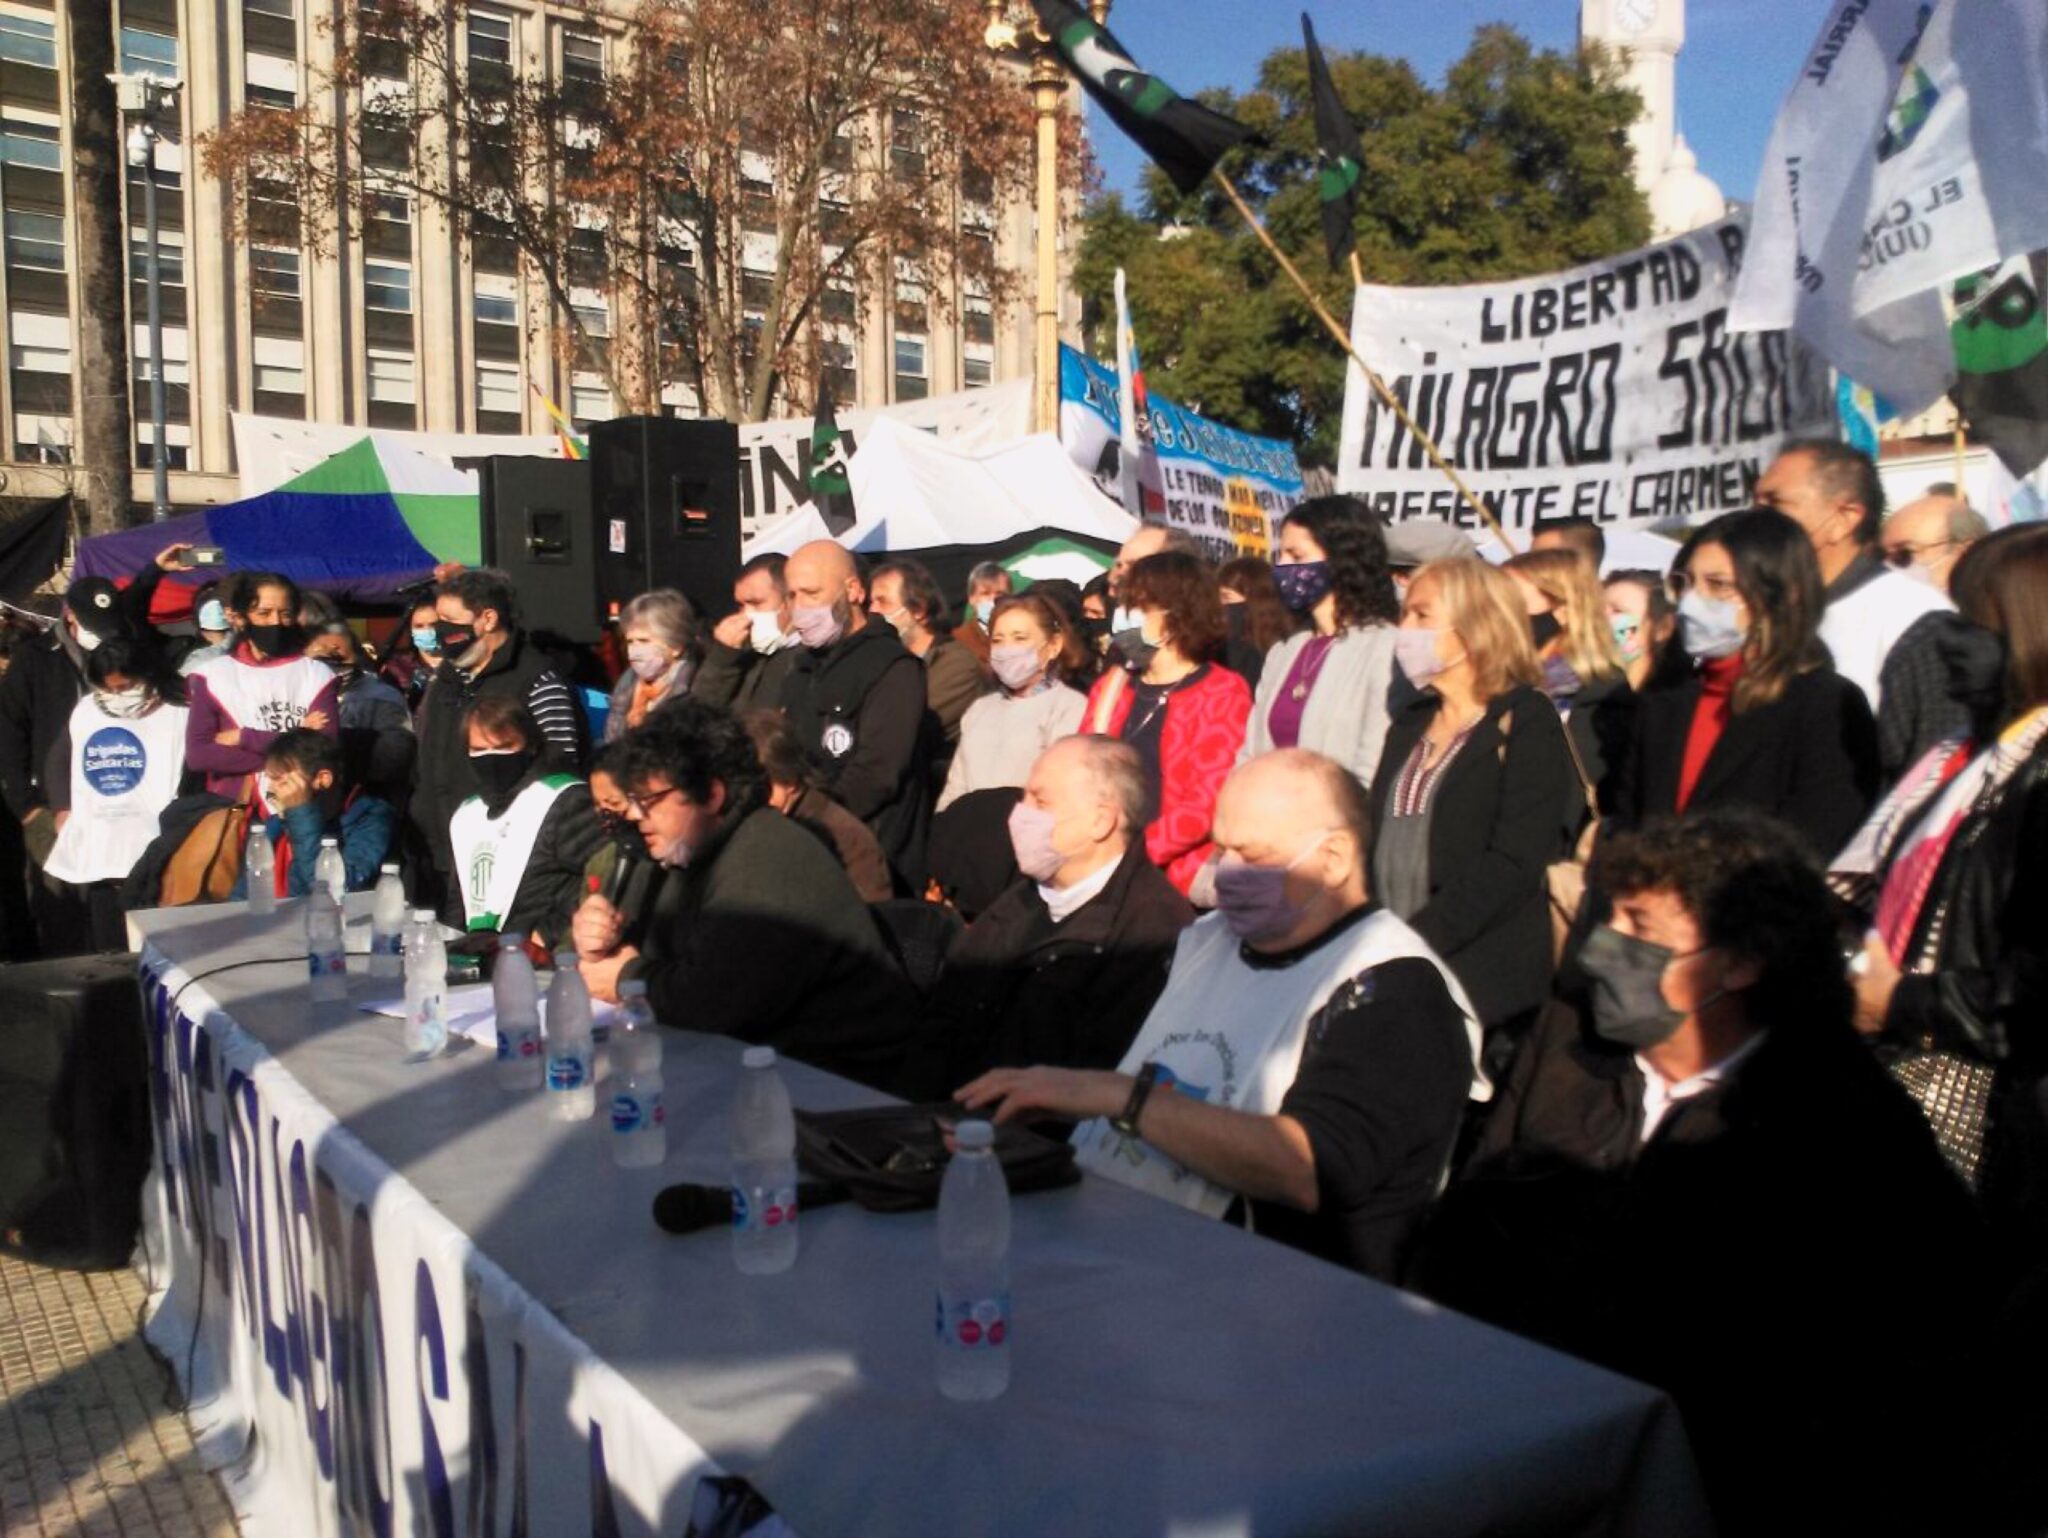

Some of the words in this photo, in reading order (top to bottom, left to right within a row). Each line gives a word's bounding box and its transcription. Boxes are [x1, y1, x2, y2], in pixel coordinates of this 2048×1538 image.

[1480, 244, 1700, 343] LIBERTAD
[1346, 486, 1560, 530] RESENTE
[1572, 480, 1617, 522] EL
[1628, 458, 1760, 519] CARMEN
